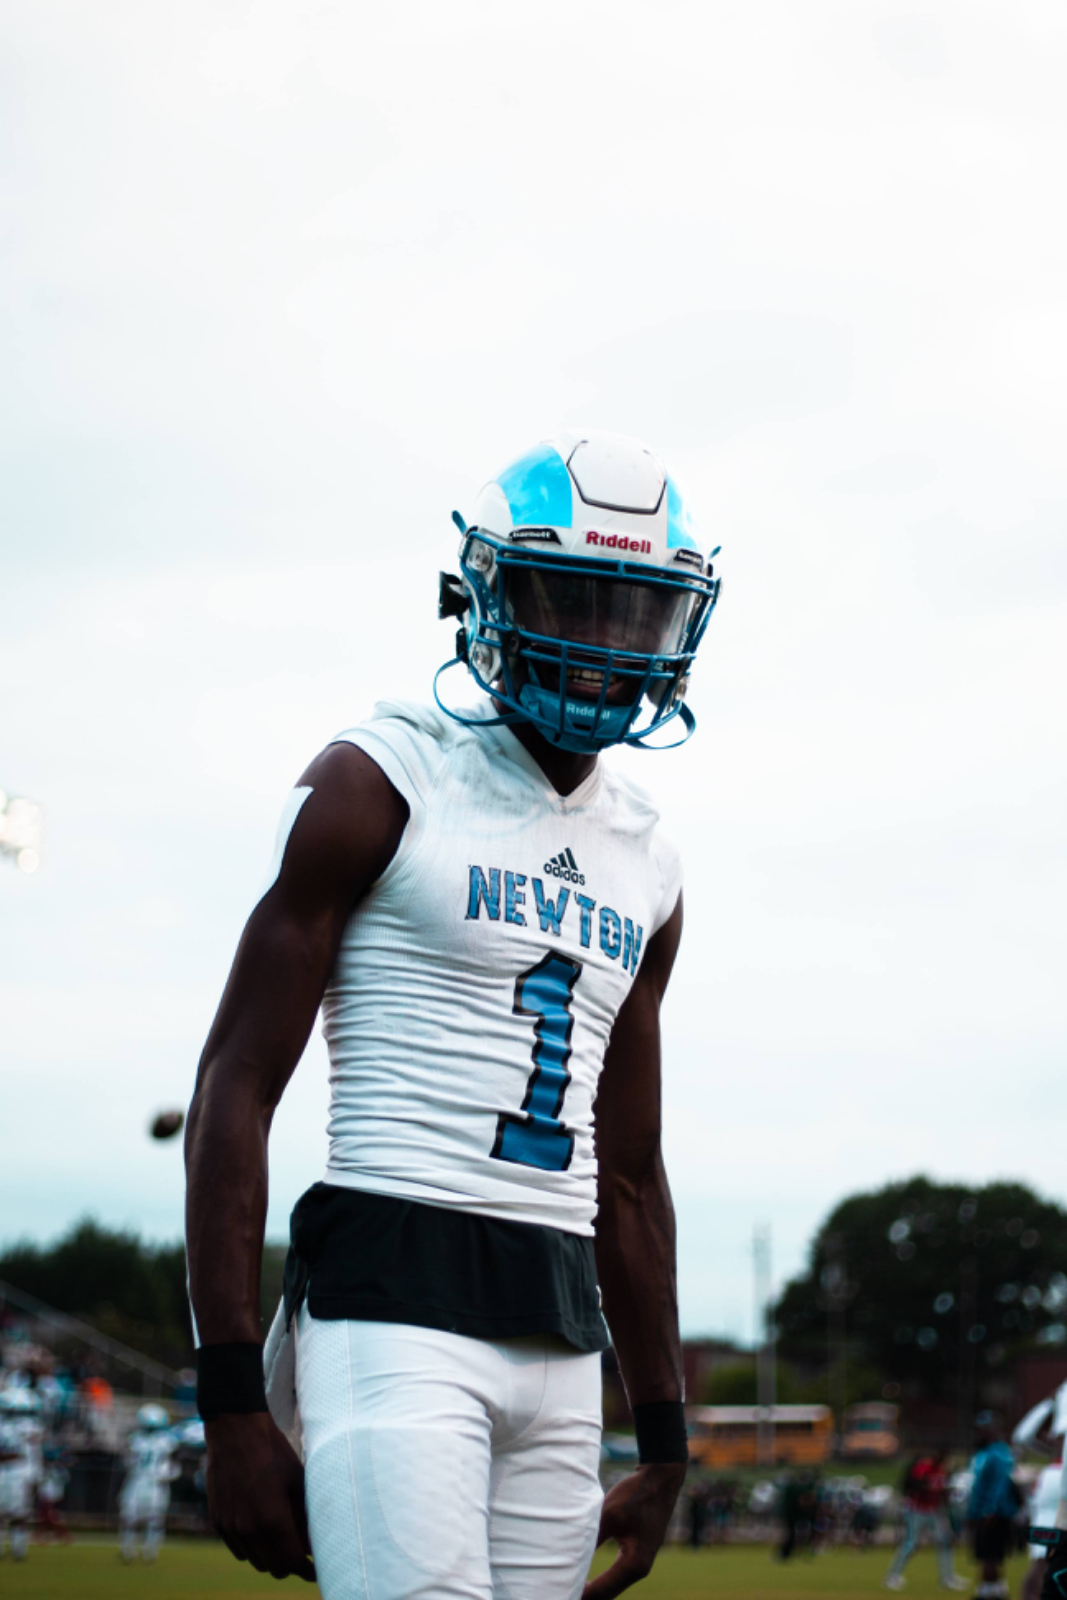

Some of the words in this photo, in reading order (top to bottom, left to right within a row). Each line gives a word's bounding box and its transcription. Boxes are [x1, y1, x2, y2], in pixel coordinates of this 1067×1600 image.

[586, 531, 651, 554] Riddell
[566, 702, 611, 720] Riddll
[543, 862, 586, 886] adidas
[464, 865, 643, 977] NEWTON
[489, 950, 582, 1171] 1
